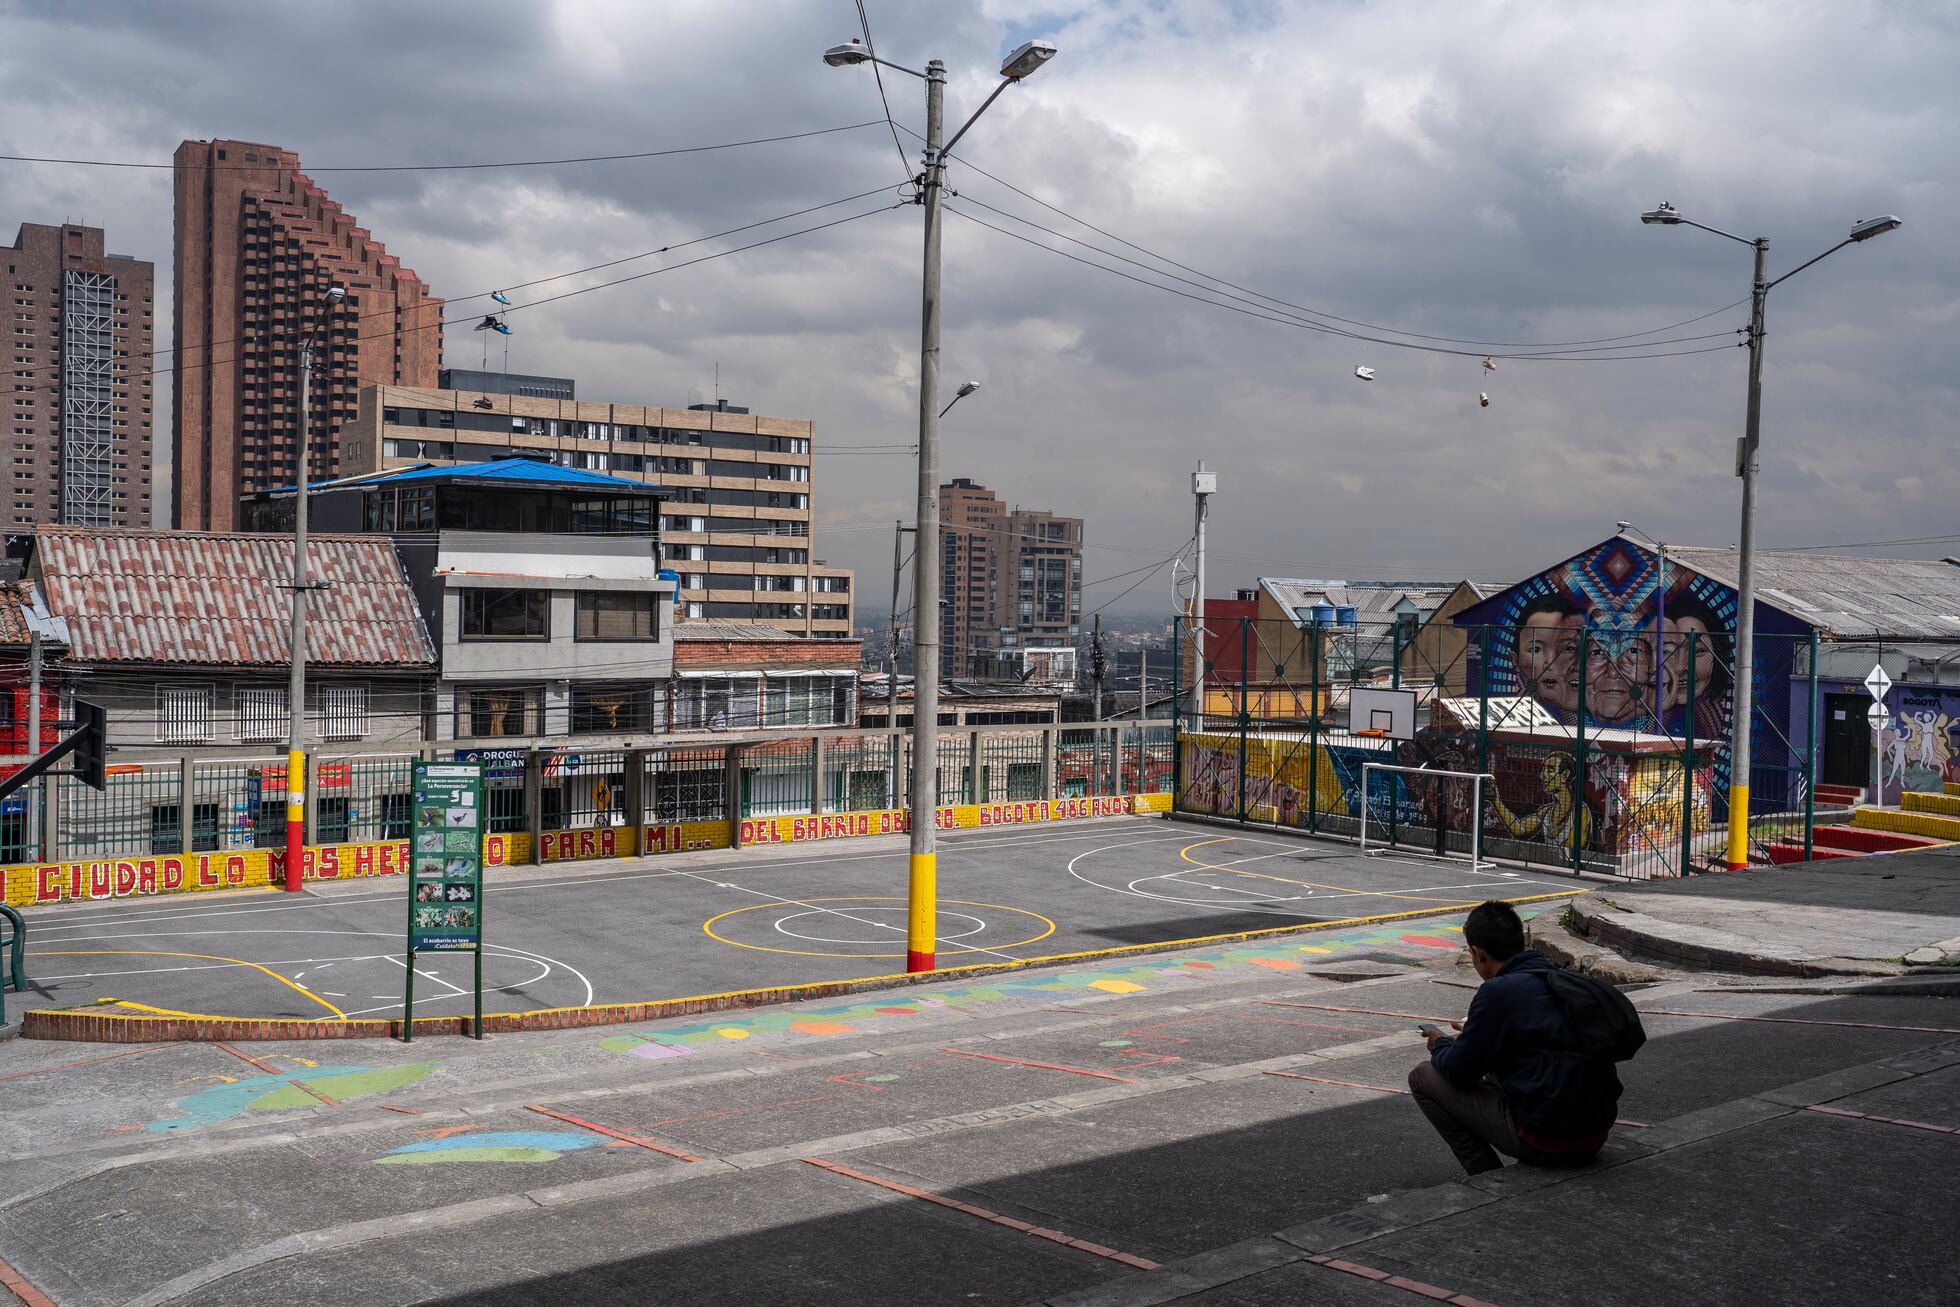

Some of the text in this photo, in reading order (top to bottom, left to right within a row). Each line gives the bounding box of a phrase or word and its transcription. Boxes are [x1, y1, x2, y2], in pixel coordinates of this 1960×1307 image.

[36, 857, 184, 902] CIUDAD
[198, 854, 246, 887] LO
[540, 827, 617, 861] PARA
[740, 820, 783, 844] DEL
[792, 813, 870, 842] BARRIO
[1054, 798, 1088, 820] 486
